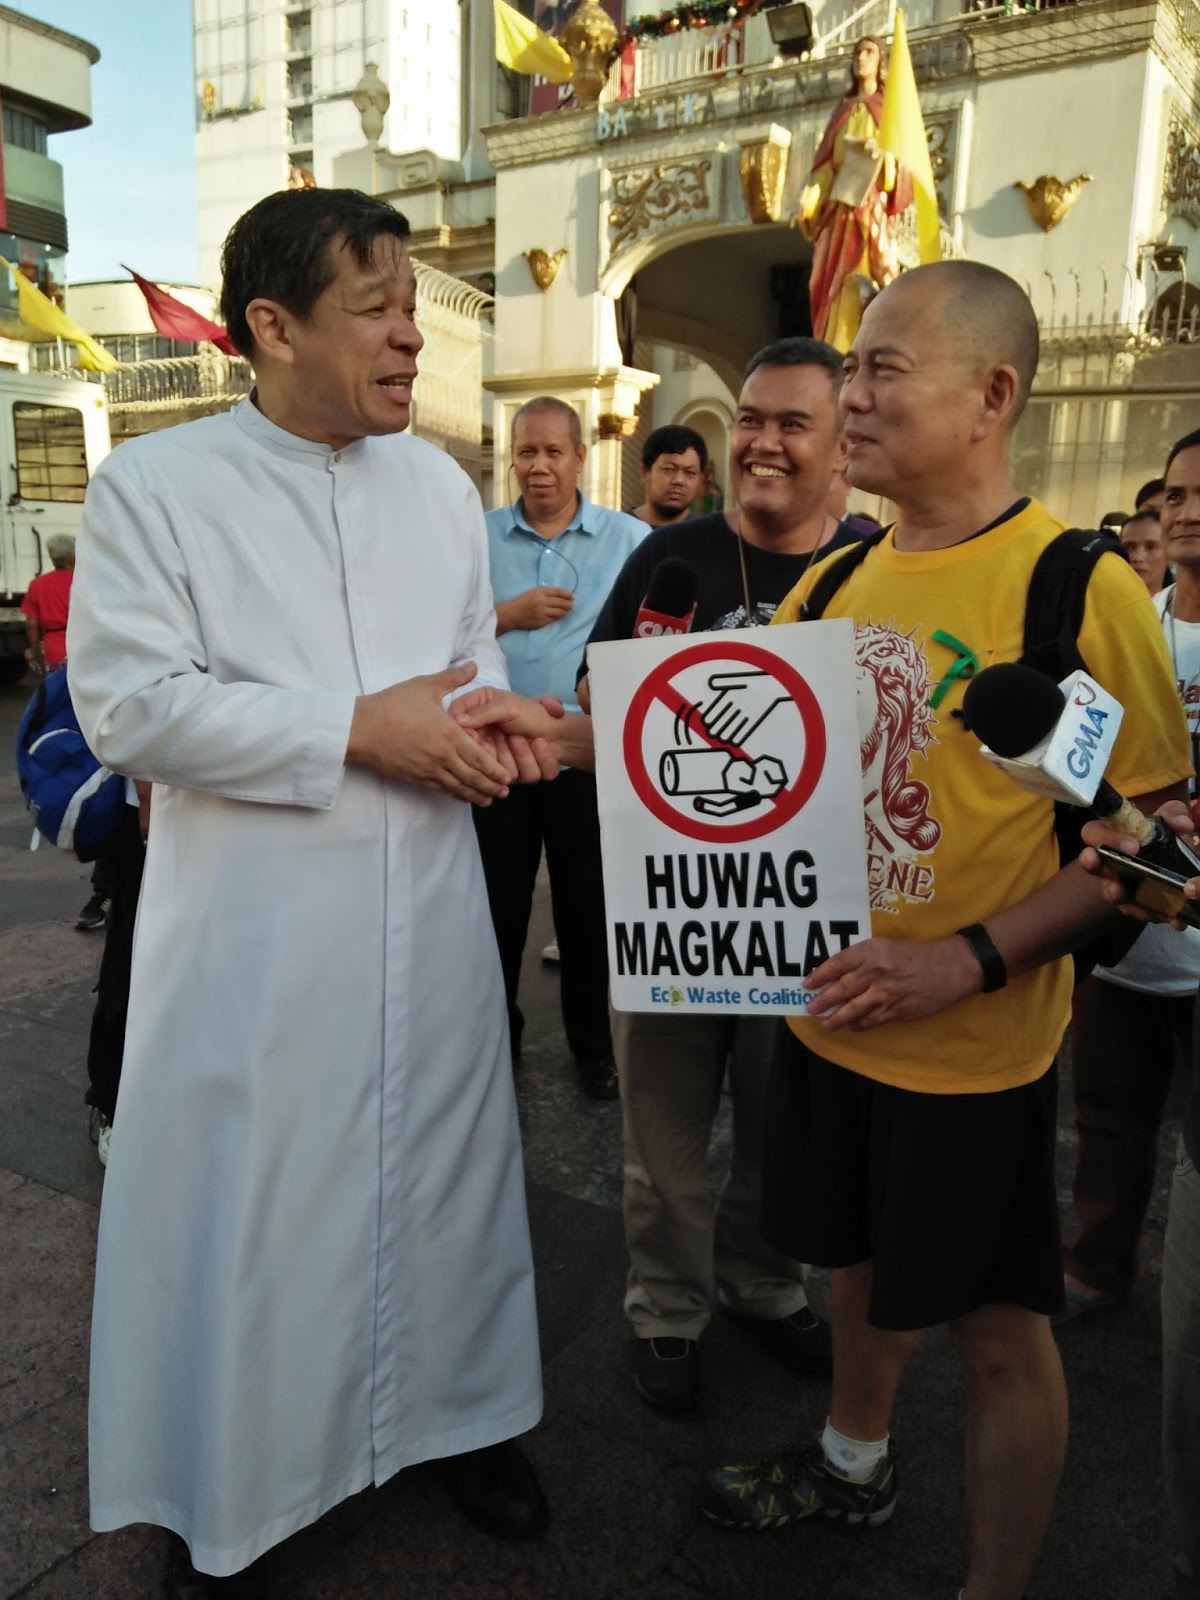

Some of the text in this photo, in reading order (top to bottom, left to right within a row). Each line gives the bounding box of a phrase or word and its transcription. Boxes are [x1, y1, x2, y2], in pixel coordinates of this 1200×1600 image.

[1066, 706, 1109, 779] GMA
[645, 849, 818, 910] HUWAG
[614, 920, 859, 977] MAGKALAT
[686, 986, 742, 1005] Waste
[748, 987, 818, 1006] Coalitio
